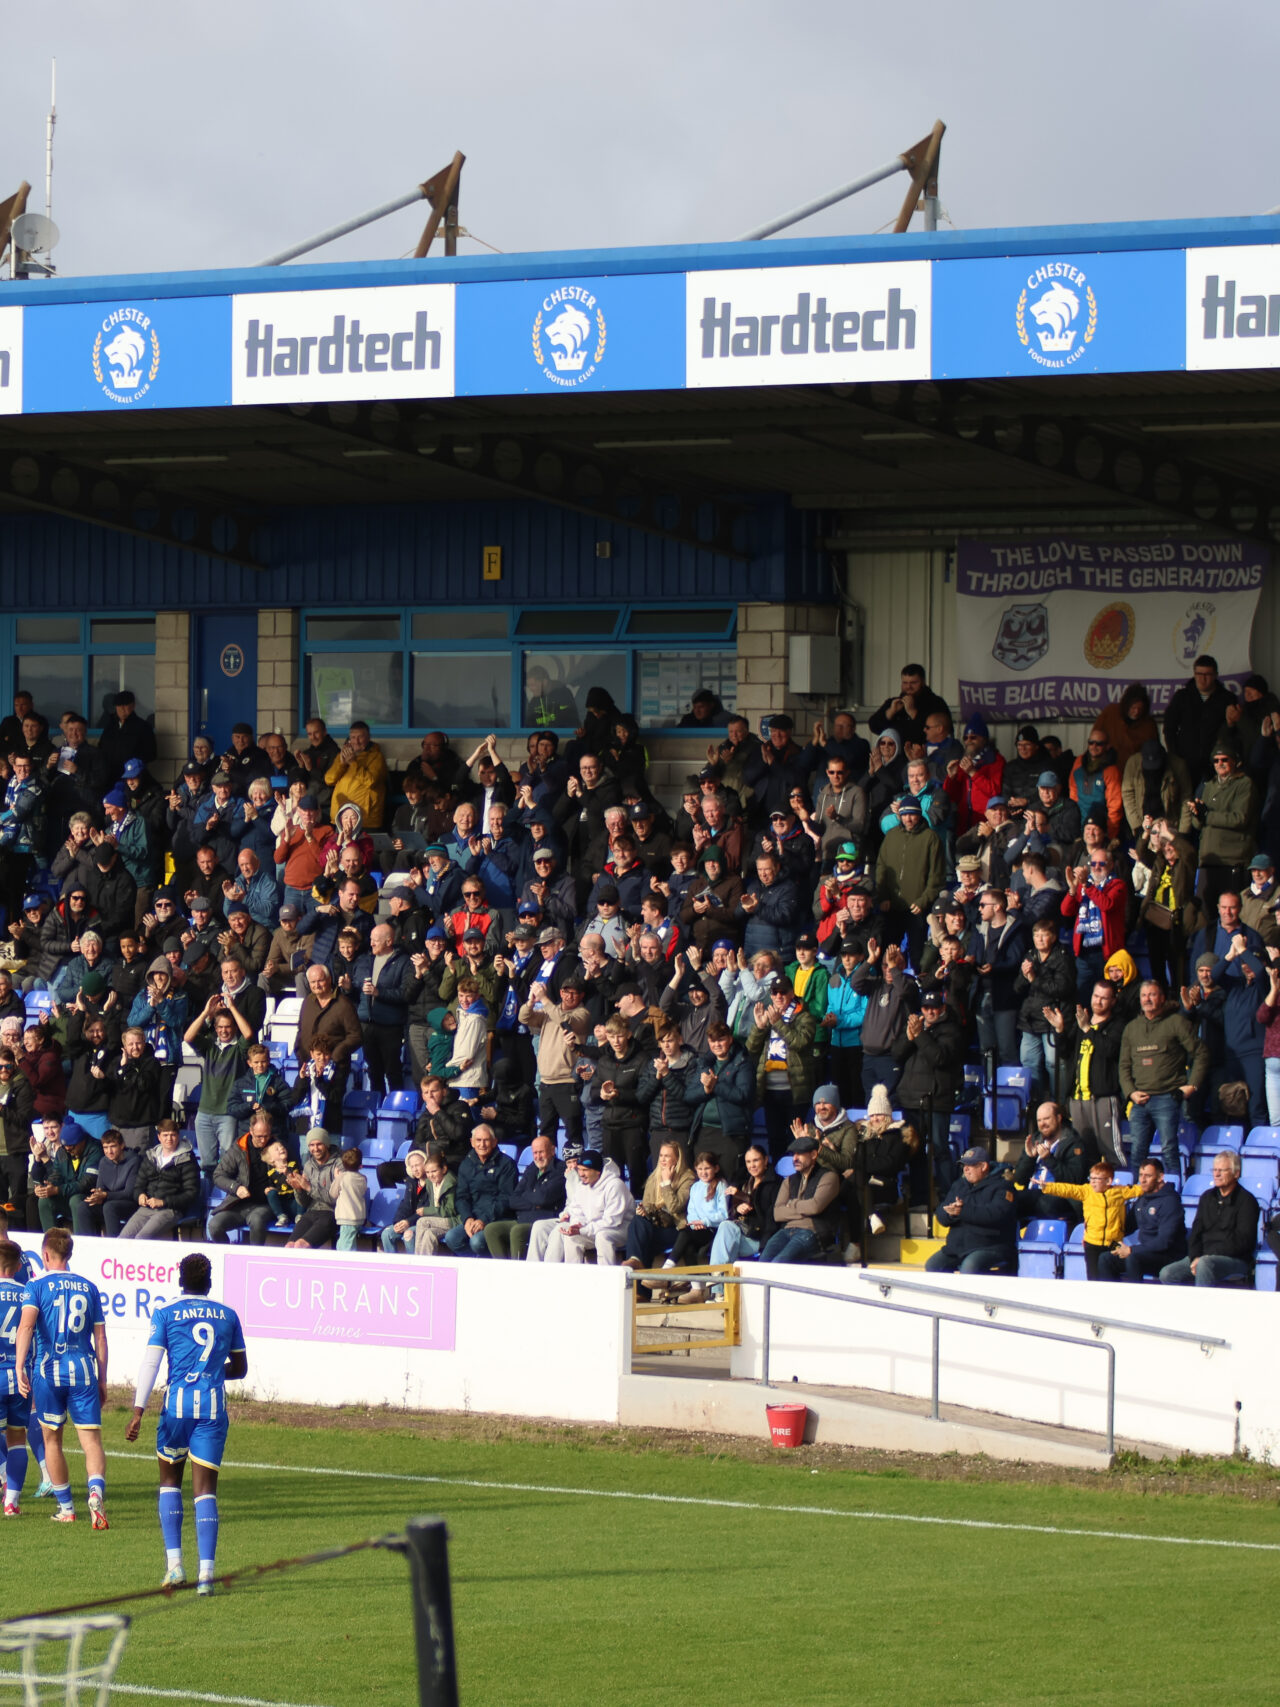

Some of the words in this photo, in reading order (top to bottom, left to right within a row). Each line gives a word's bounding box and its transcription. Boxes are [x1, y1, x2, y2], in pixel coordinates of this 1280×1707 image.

[1027, 262, 1086, 290] CHESTER
[542, 285, 597, 312] CHESTER
[1201, 274, 1280, 339] Har
[102, 308, 152, 333] CHESTER
[700, 288, 917, 358] Hardtech
[245, 311, 441, 377] Hardtech
[1027, 347, 1065, 368] FOOTBALL
[1066, 345, 1086, 364] CLUB
[542, 367, 577, 387] FOOTBALL
[577, 364, 596, 383] CLUB
[101, 384, 133, 404] FOOTBALL
[133, 382, 150, 401] CLUB
[488, 552, 498, 573] F
[990, 547, 1035, 567] THE
[1037, 541, 1094, 564] LOVE
[1097, 543, 1175, 563] PASSED
[1181, 543, 1243, 563] DOWN
[966, 565, 1072, 593] THROUGH
[1079, 567, 1123, 587] THE
[1128, 564, 1262, 588] GENERATIONS
[961, 686, 998, 706] THE
[1004, 681, 1057, 705] BLUE
[1060, 682, 1101, 703] AND
[1107, 683, 1171, 704] WITE
[48, 1279, 89, 1292] P.JONES
[259, 1277, 420, 1318] CURRANS
[53, 1294, 88, 1334] 18
[173, 1307, 227, 1321] ZANZALA
[312, 1311, 364, 1338] homes
[191, 1321, 215, 1362] 9
[771, 1427, 793, 1436] FIRE
